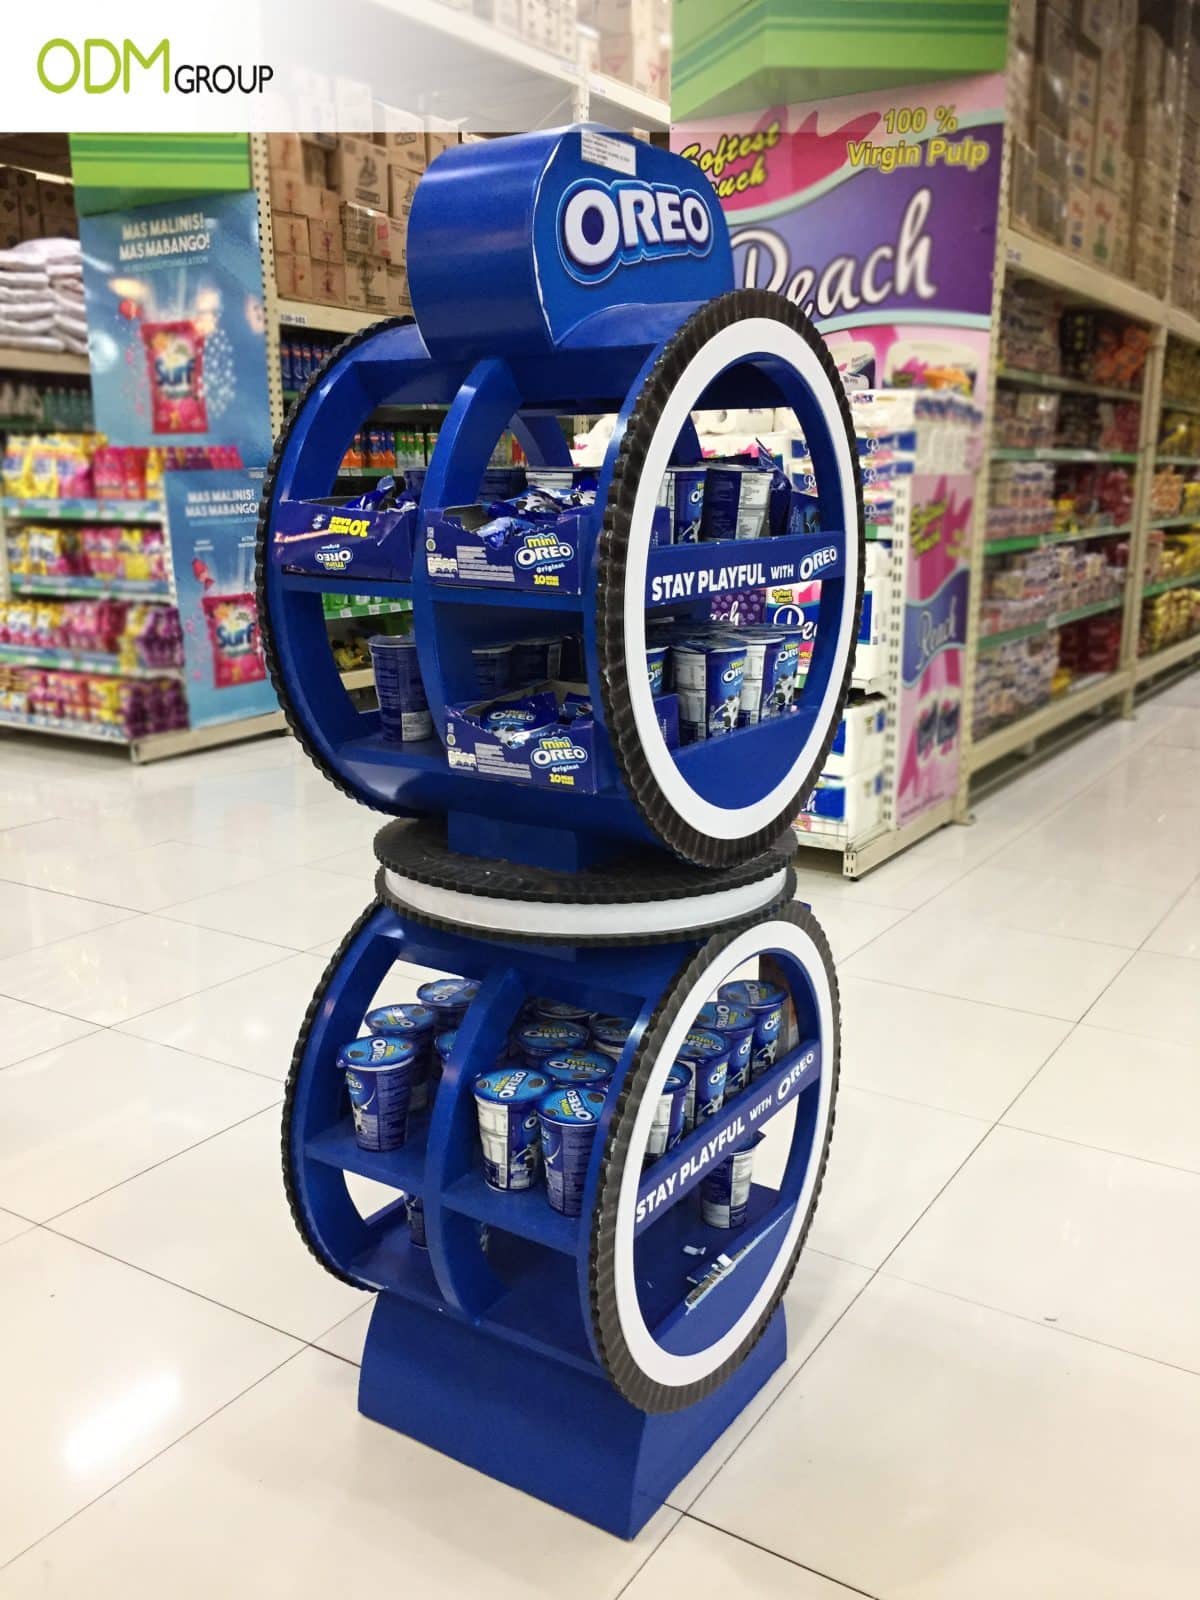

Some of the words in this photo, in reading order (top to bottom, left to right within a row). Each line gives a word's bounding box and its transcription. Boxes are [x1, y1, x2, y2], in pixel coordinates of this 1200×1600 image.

[884, 107, 928, 133] 100
[935, 105, 958, 132] %
[847, 141, 923, 173] Virgin
[927, 136, 989, 174] Pulp
[711, 154, 767, 197] uch
[122, 222, 148, 241] MAS
[150, 212, 205, 237] MALINIS!
[564, 188, 710, 266] OREO
[119, 243, 145, 260] MAS
[145, 232, 211, 256] MABANGO!
[316, 549, 352, 563] OREO
[517, 545, 572, 566] OREO
[527, 535, 558, 549] mini
[533, 574, 546, 586] 10
[651, 571, 695, 602] STAY
[697, 562, 766, 594] PLAYFUL
[770, 563, 794, 580] WITH
[800, 547, 838, 580] OREO
[533, 748, 586, 766] OREO
[542, 739, 571, 750] mini
[498, 1071, 528, 1099] OREO
[566, 1089, 593, 1121] OREO
[635, 1172, 678, 1224] STAY
[679, 1115, 746, 1186] PLAYFUL
[749, 1094, 773, 1121] WITH
[777, 1052, 814, 1101] OREO
